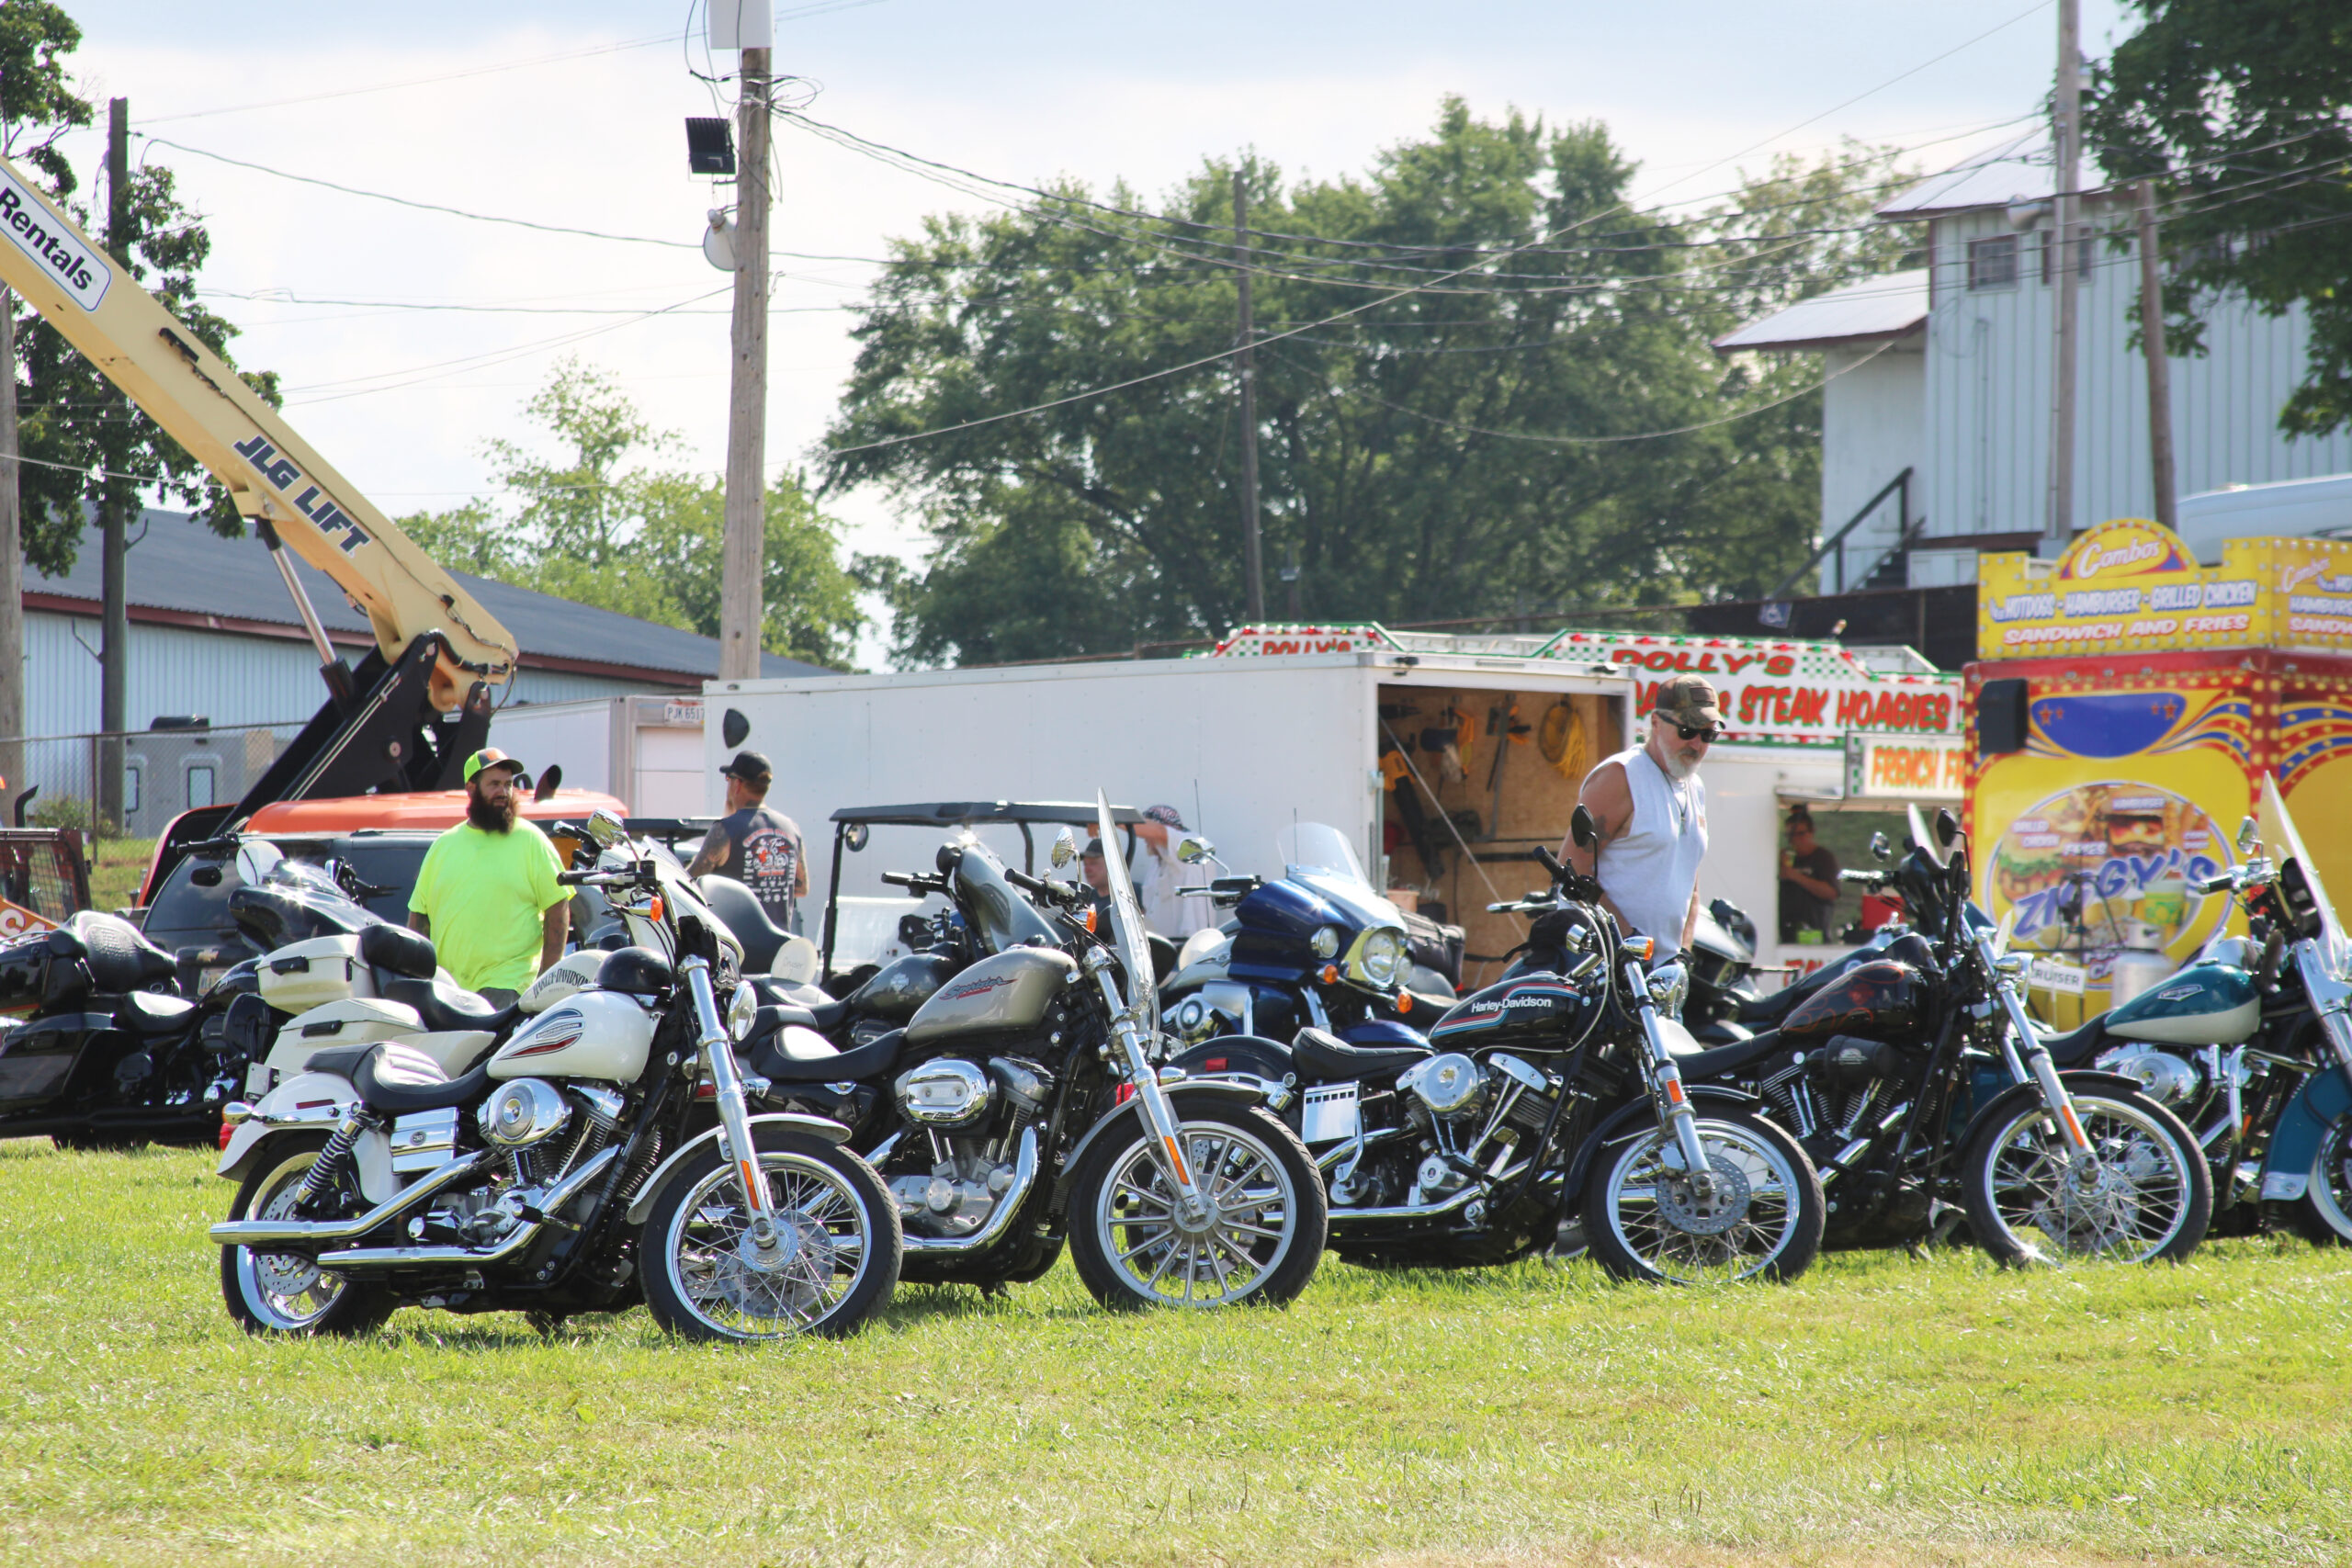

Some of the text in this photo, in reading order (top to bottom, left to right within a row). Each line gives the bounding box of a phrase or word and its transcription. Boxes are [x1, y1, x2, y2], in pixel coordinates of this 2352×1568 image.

[0, 186, 93, 290] Rentals
[233, 434, 370, 553] JLG LIFT
[2077, 539, 2161, 579] Combos
[2065, 588, 2141, 617] HAMBURGER
[2152, 584, 2201, 612] GRILLED
[2204, 581, 2257, 608] CHICKEN
[2004, 615, 2250, 646] SANDWICH AND FRIES
[1612, 649, 1795, 676] DOLLY'S
[1737, 684, 1829, 728] STEAK
[1836, 690, 1951, 732] HOAGIES
[1871, 746, 1939, 788] FRENCH
[1471, 997, 1552, 1013] Harley-Davidson
